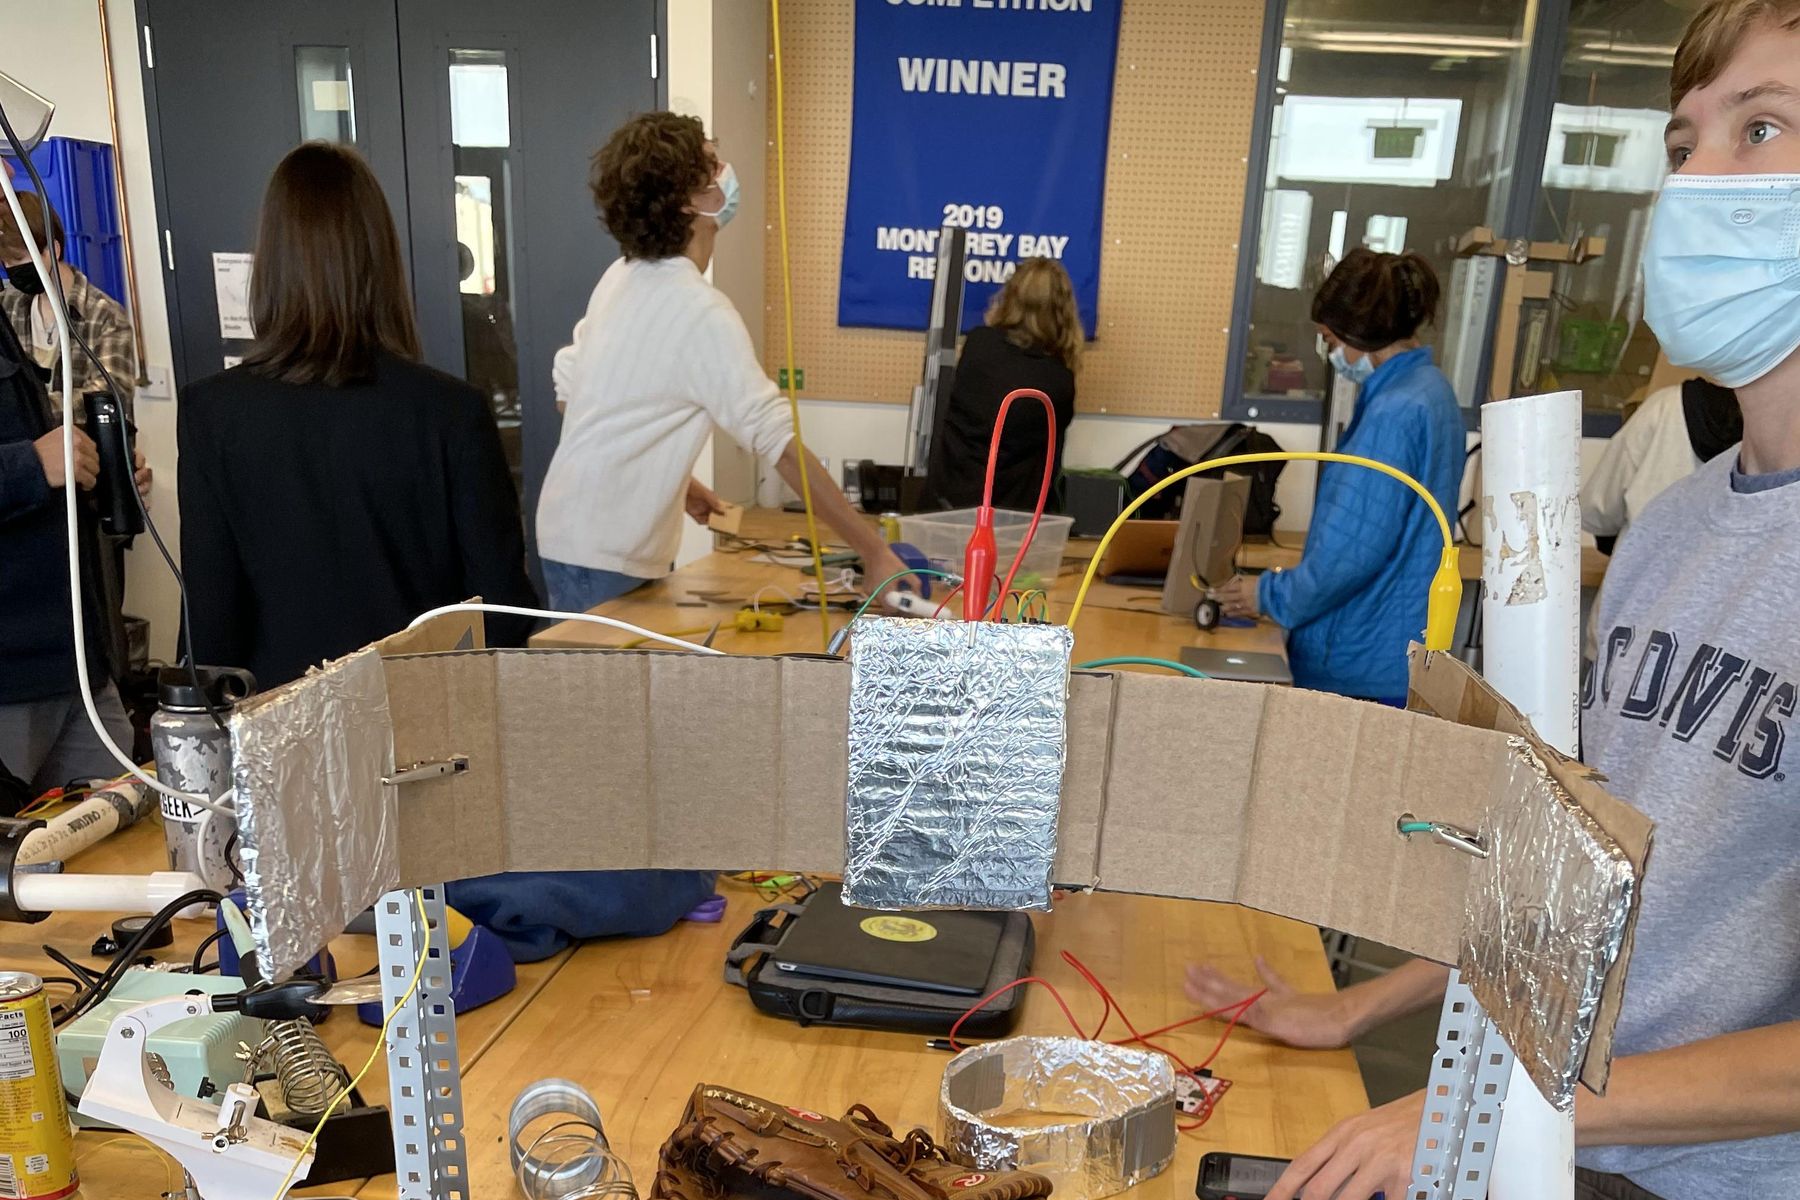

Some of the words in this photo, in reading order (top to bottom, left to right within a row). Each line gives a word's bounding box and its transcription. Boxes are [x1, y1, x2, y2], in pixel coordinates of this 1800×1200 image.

[898, 57, 1067, 98] WINNER
[942, 204, 1003, 229] 2019
[877, 227, 1014, 257] MONREY
[1018, 235, 1069, 259] BAY
[162, 792, 192, 818] GEEK
[8, 1029, 27, 1038] 100
